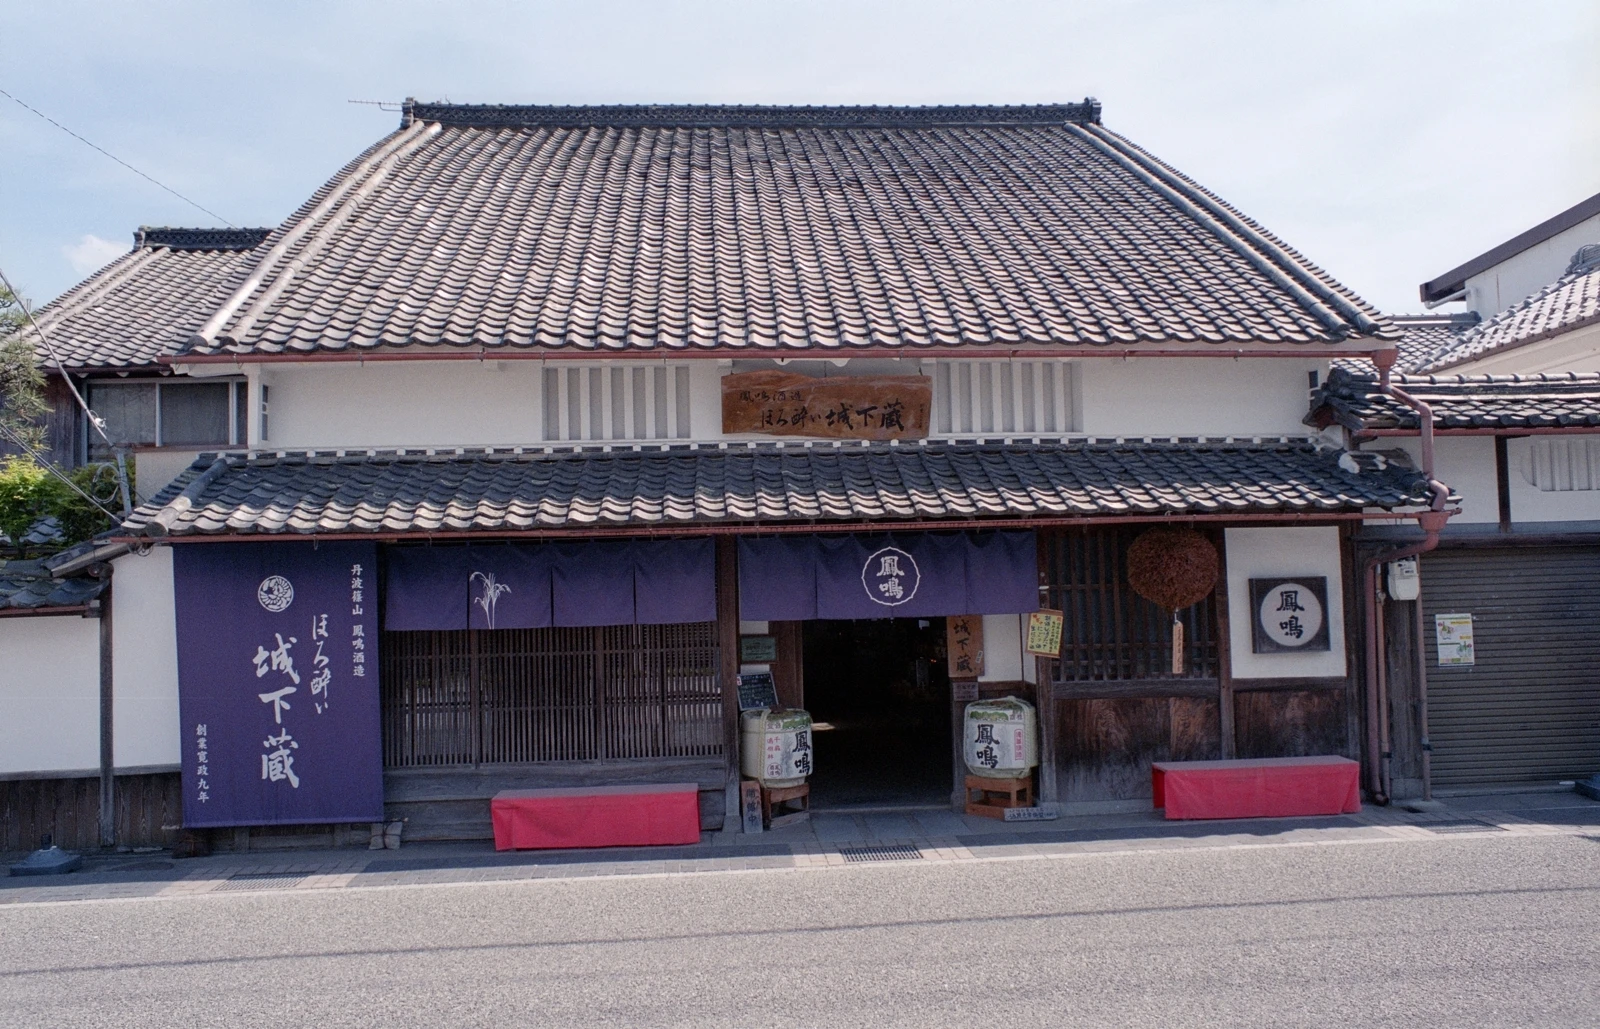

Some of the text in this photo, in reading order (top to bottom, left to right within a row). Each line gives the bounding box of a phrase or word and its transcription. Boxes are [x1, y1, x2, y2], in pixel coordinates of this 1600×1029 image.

[761, 405, 821, 428] ほろ酔い
[825, 397, 904, 432] 城下蔵
[876, 555, 905, 599] 鳳鳴
[351, 564, 366, 677] 丹波篠山 鳳鳴酒造
[1276, 590, 1305, 639] 鳳鳴
[310, 613, 332, 715] ほろ酔い
[953, 618, 973, 673] 城下蔵
[252, 632, 300, 789] 城下蔵
[196, 724, 210, 804] 創業寛政九年
[792, 730, 811, 775] 鳳鳴
[974, 724, 1000, 769] 鳳鳴
